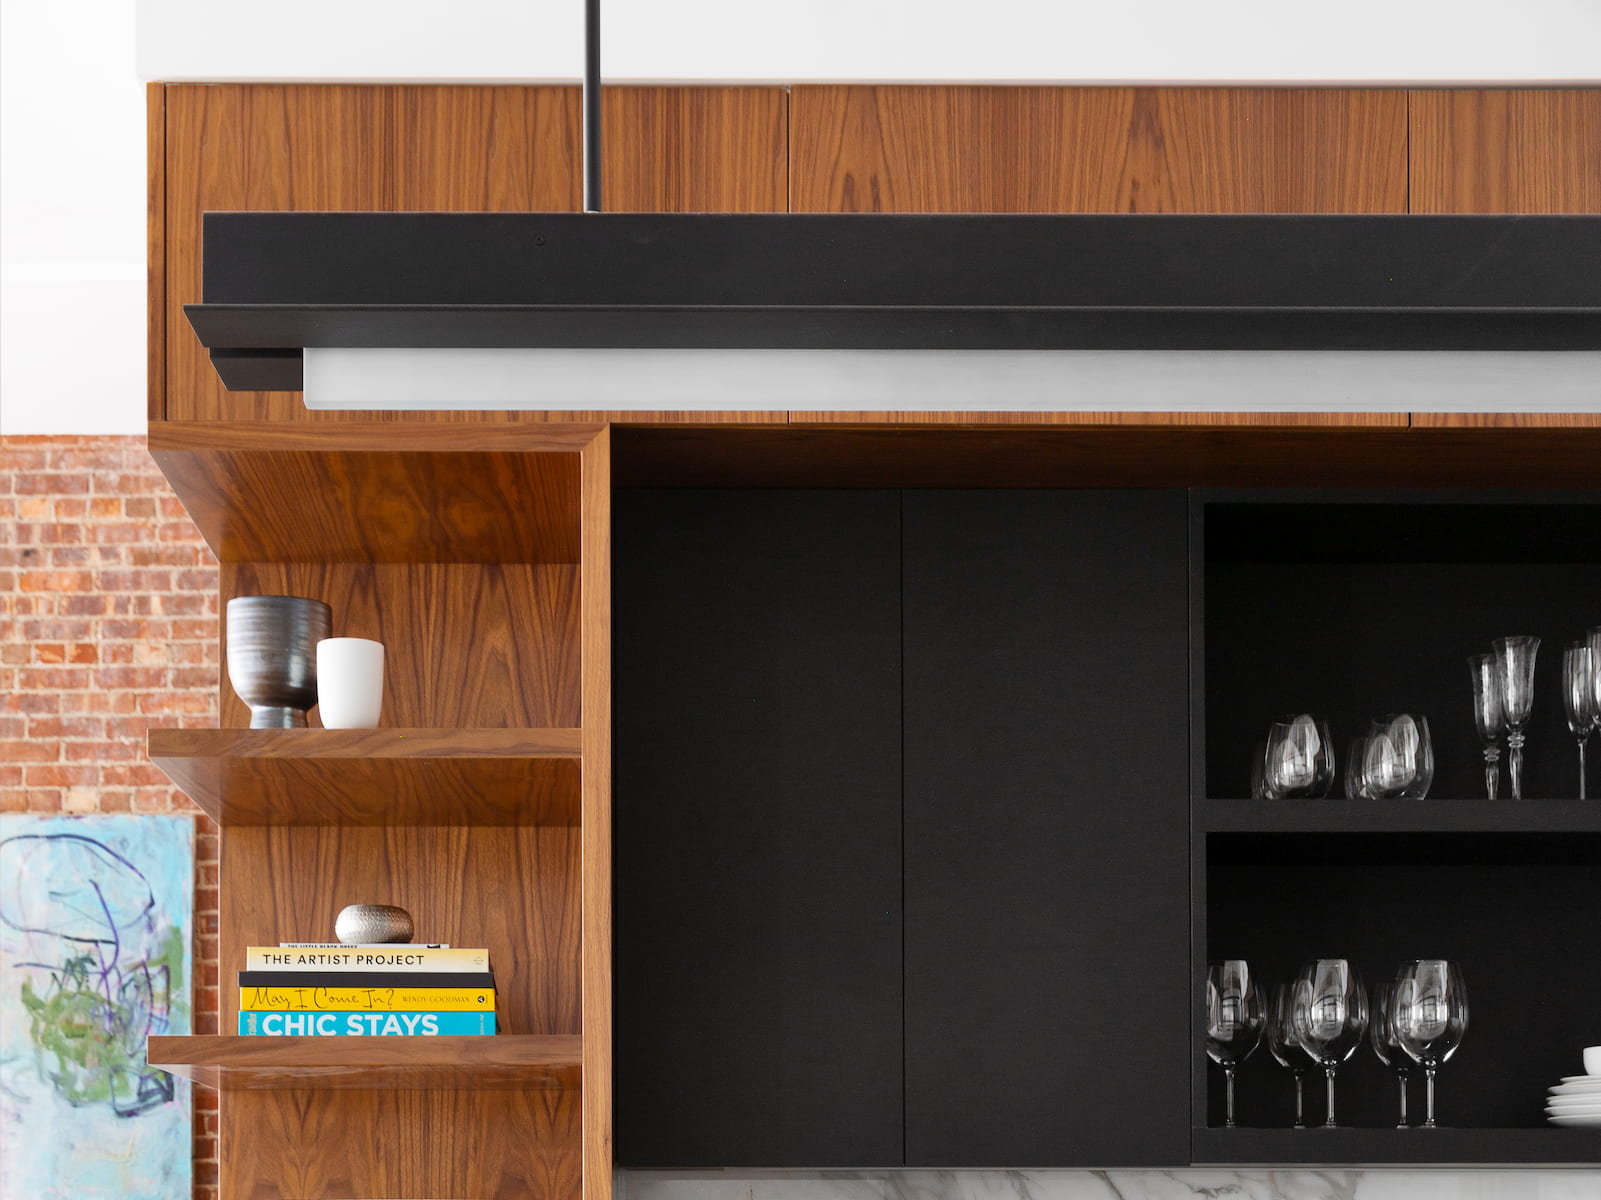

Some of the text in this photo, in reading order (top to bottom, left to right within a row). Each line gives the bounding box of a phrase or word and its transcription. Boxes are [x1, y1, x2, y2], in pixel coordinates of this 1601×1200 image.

[263, 954, 425, 965] THE ARTIST PROJECT
[250, 986, 395, 1010] May I Come In?
[262, 1014, 337, 1036] CHIC
[346, 1014, 439, 1036] STAYS
